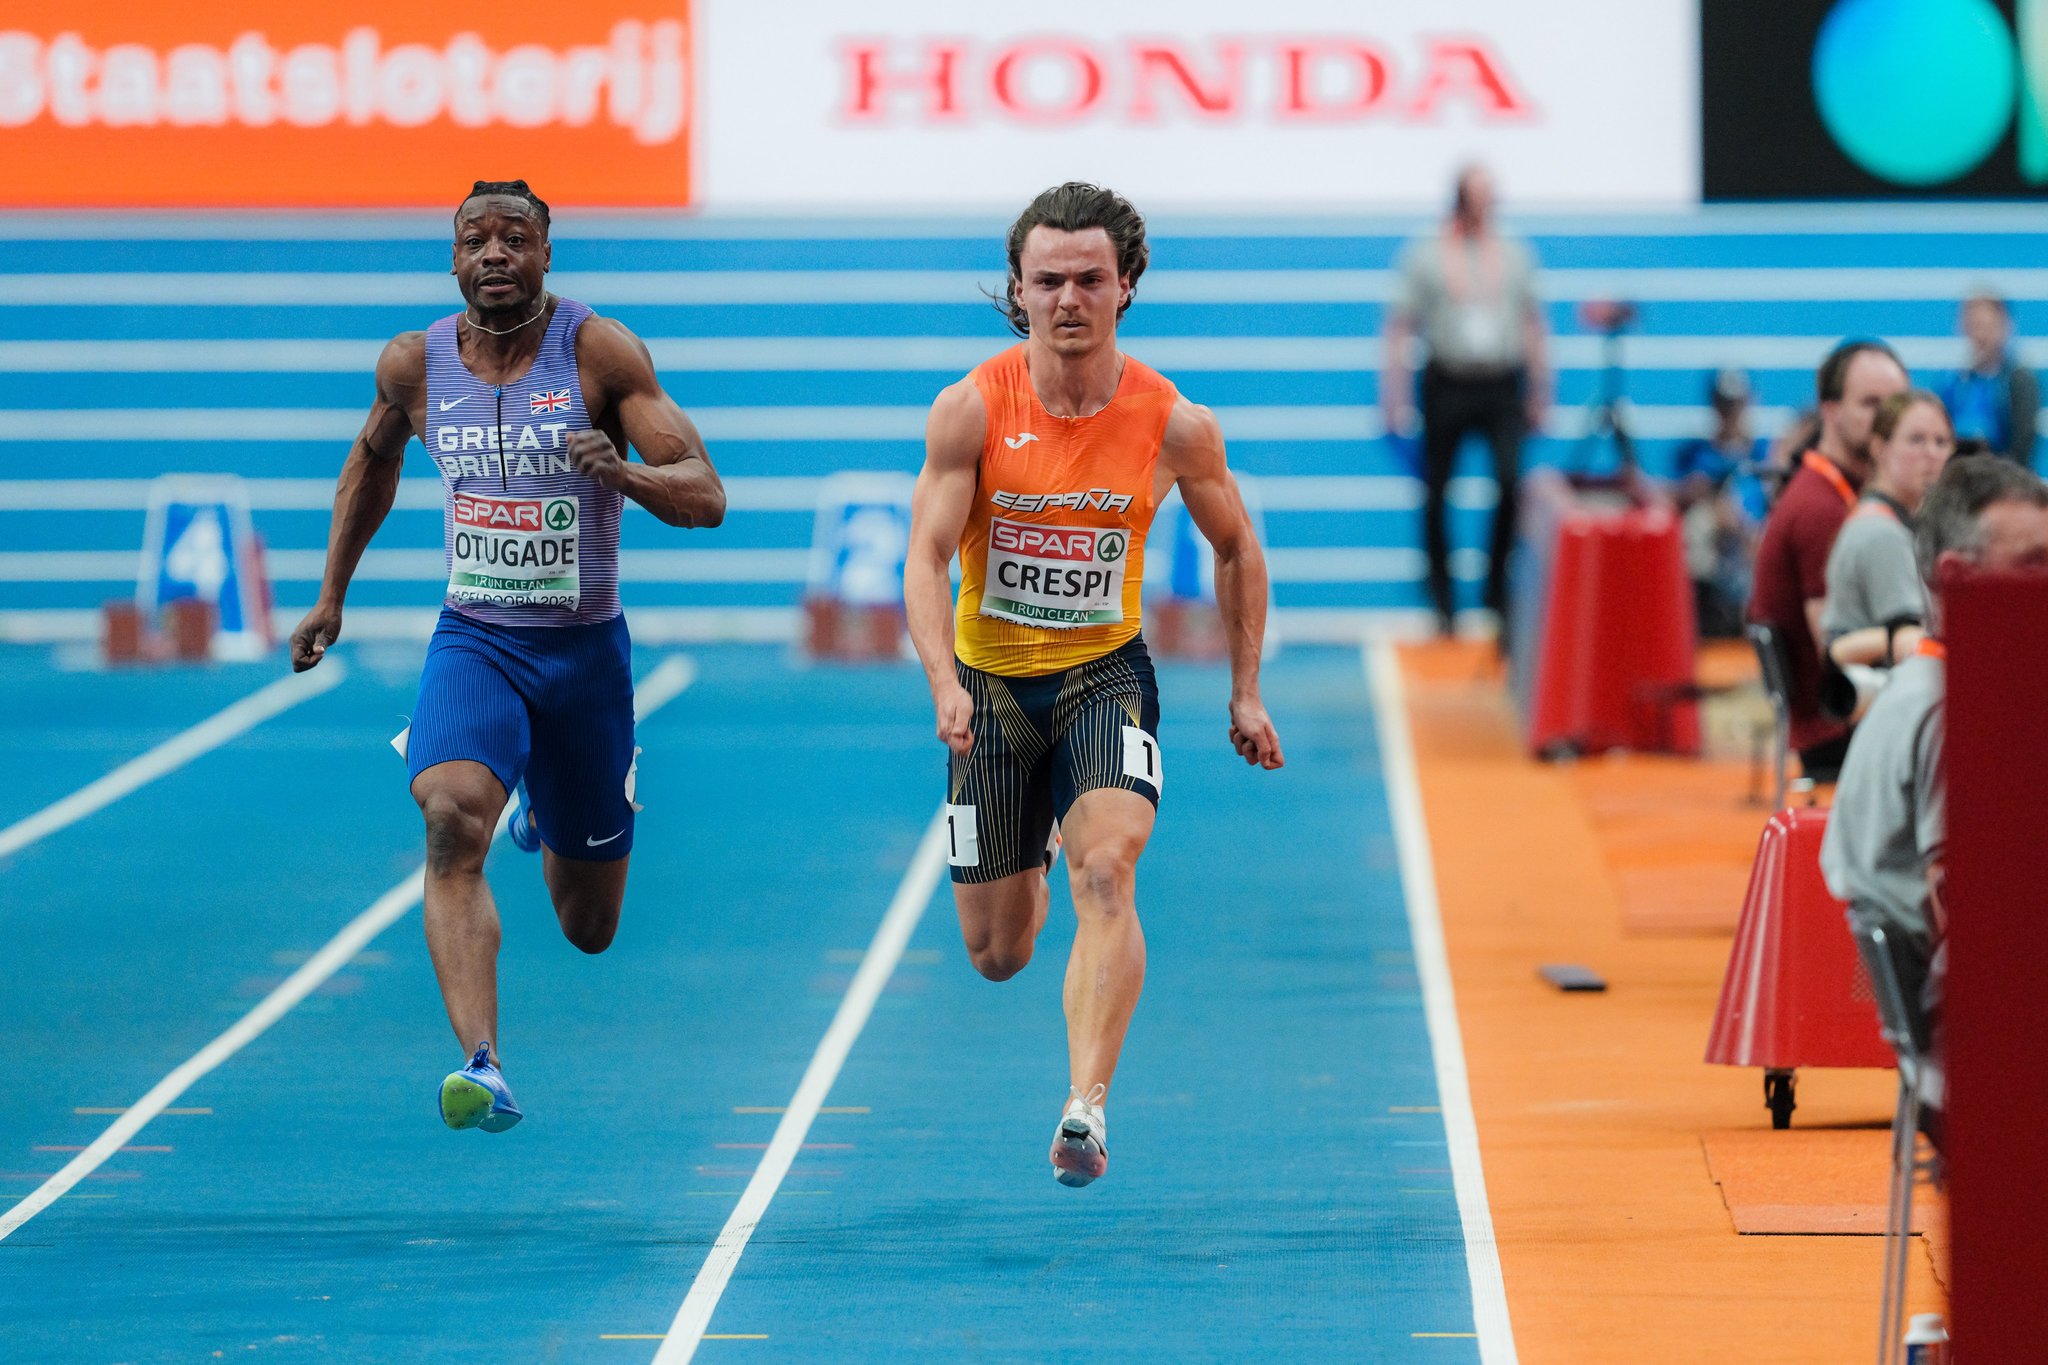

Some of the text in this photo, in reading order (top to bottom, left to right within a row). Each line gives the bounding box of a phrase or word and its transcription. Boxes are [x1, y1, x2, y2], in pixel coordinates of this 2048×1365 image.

[0, 26, 685, 143] Staatsloterij
[840, 38, 1532, 122] HONDA
[437, 422, 567, 451] GREAT
[439, 453, 572, 478] BRITAIN
[456, 498, 540, 527] SPAR
[990, 488, 1134, 513] ESPAÑA
[455, 531, 575, 567] OTUGADE
[994, 526, 1092, 558] SPAR
[480, 576, 503, 590] RUN
[998, 560, 1112, 598] CRESPI
[541, 596, 575, 606] 2025
[1011, 602, 1016, 612] I
[1018, 604, 1044, 618] RUN
[1143, 740, 1154, 778] 1
[948, 815, 957, 858] 1
